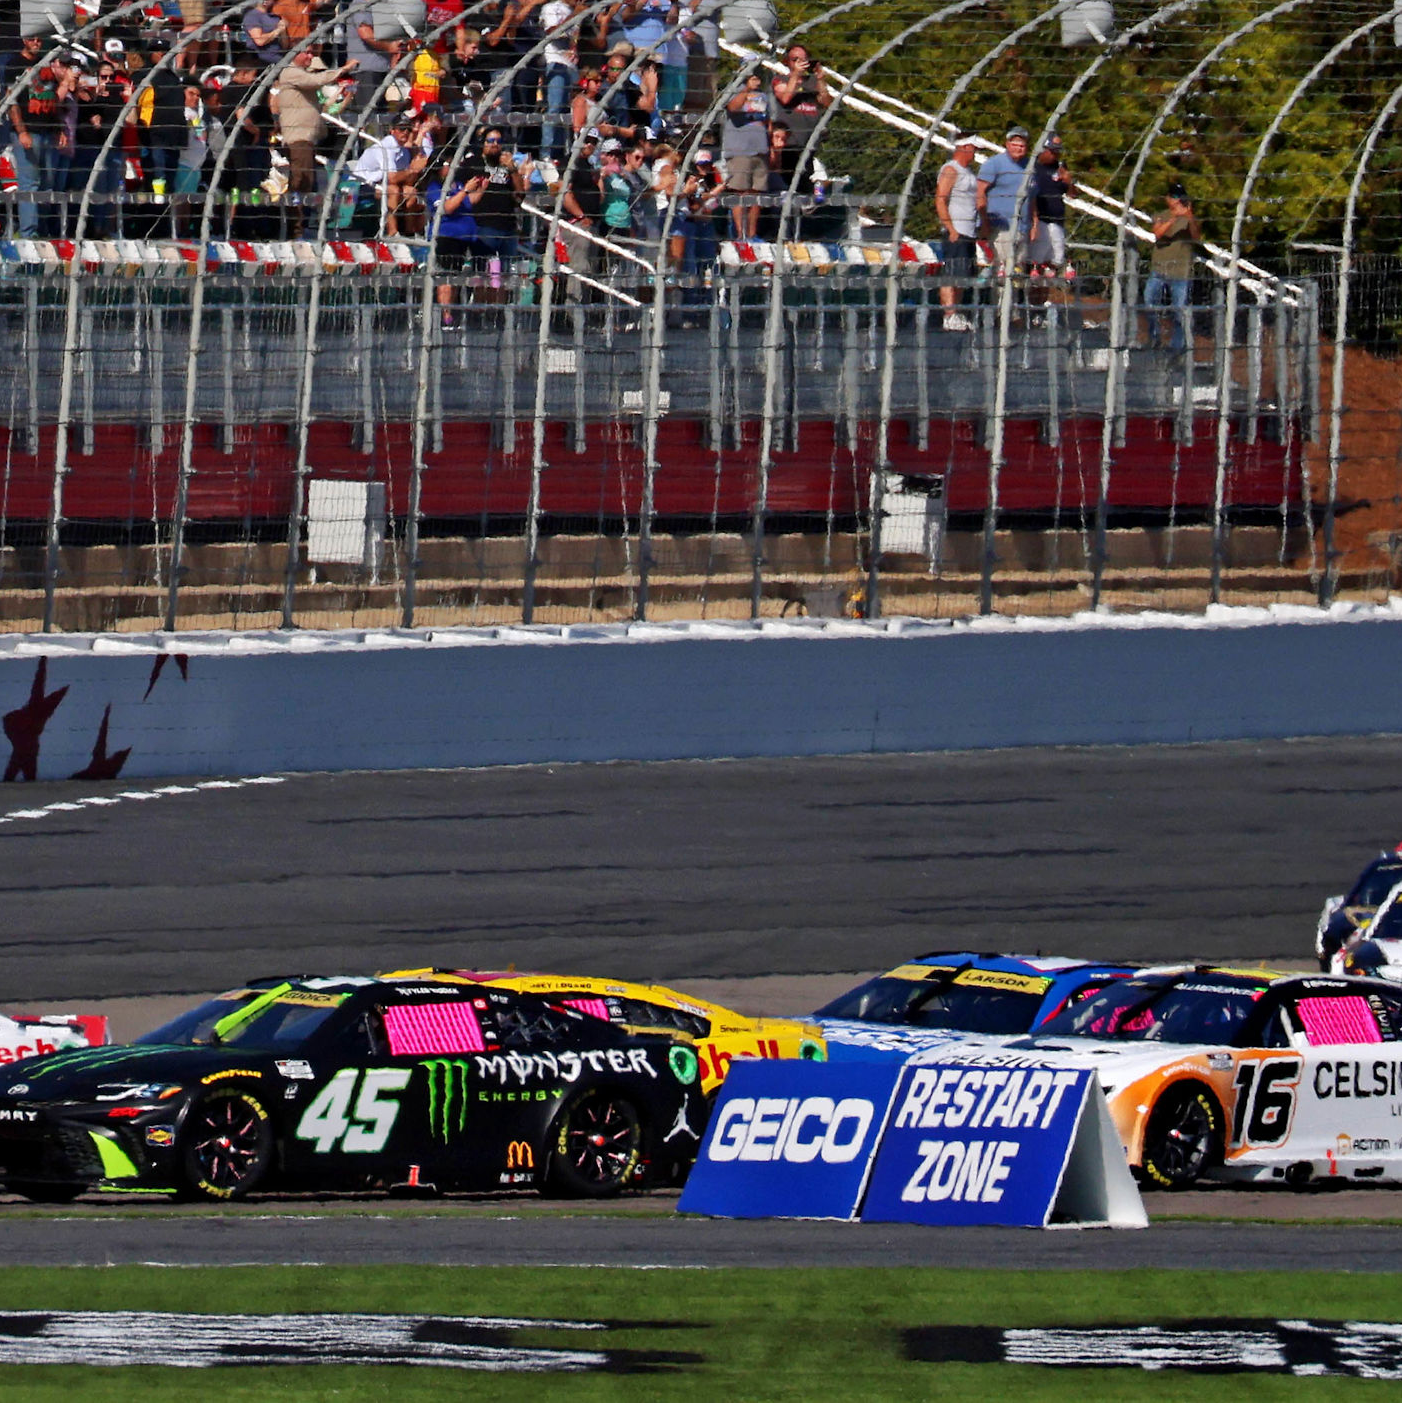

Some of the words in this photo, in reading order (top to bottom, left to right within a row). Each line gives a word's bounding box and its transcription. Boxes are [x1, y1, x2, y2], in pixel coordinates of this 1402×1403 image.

[963, 973, 1031, 988] LARSON
[697, 1039, 780, 1080] hll
[295, 1067, 414, 1154] 45
[478, 1087, 565, 1102] ENERGY
[894, 1068, 1080, 1130] RESTART
[1232, 1057, 1303, 1149] 16
[707, 1097, 875, 1164] GEICO
[901, 1140, 1020, 1203] ZONE
